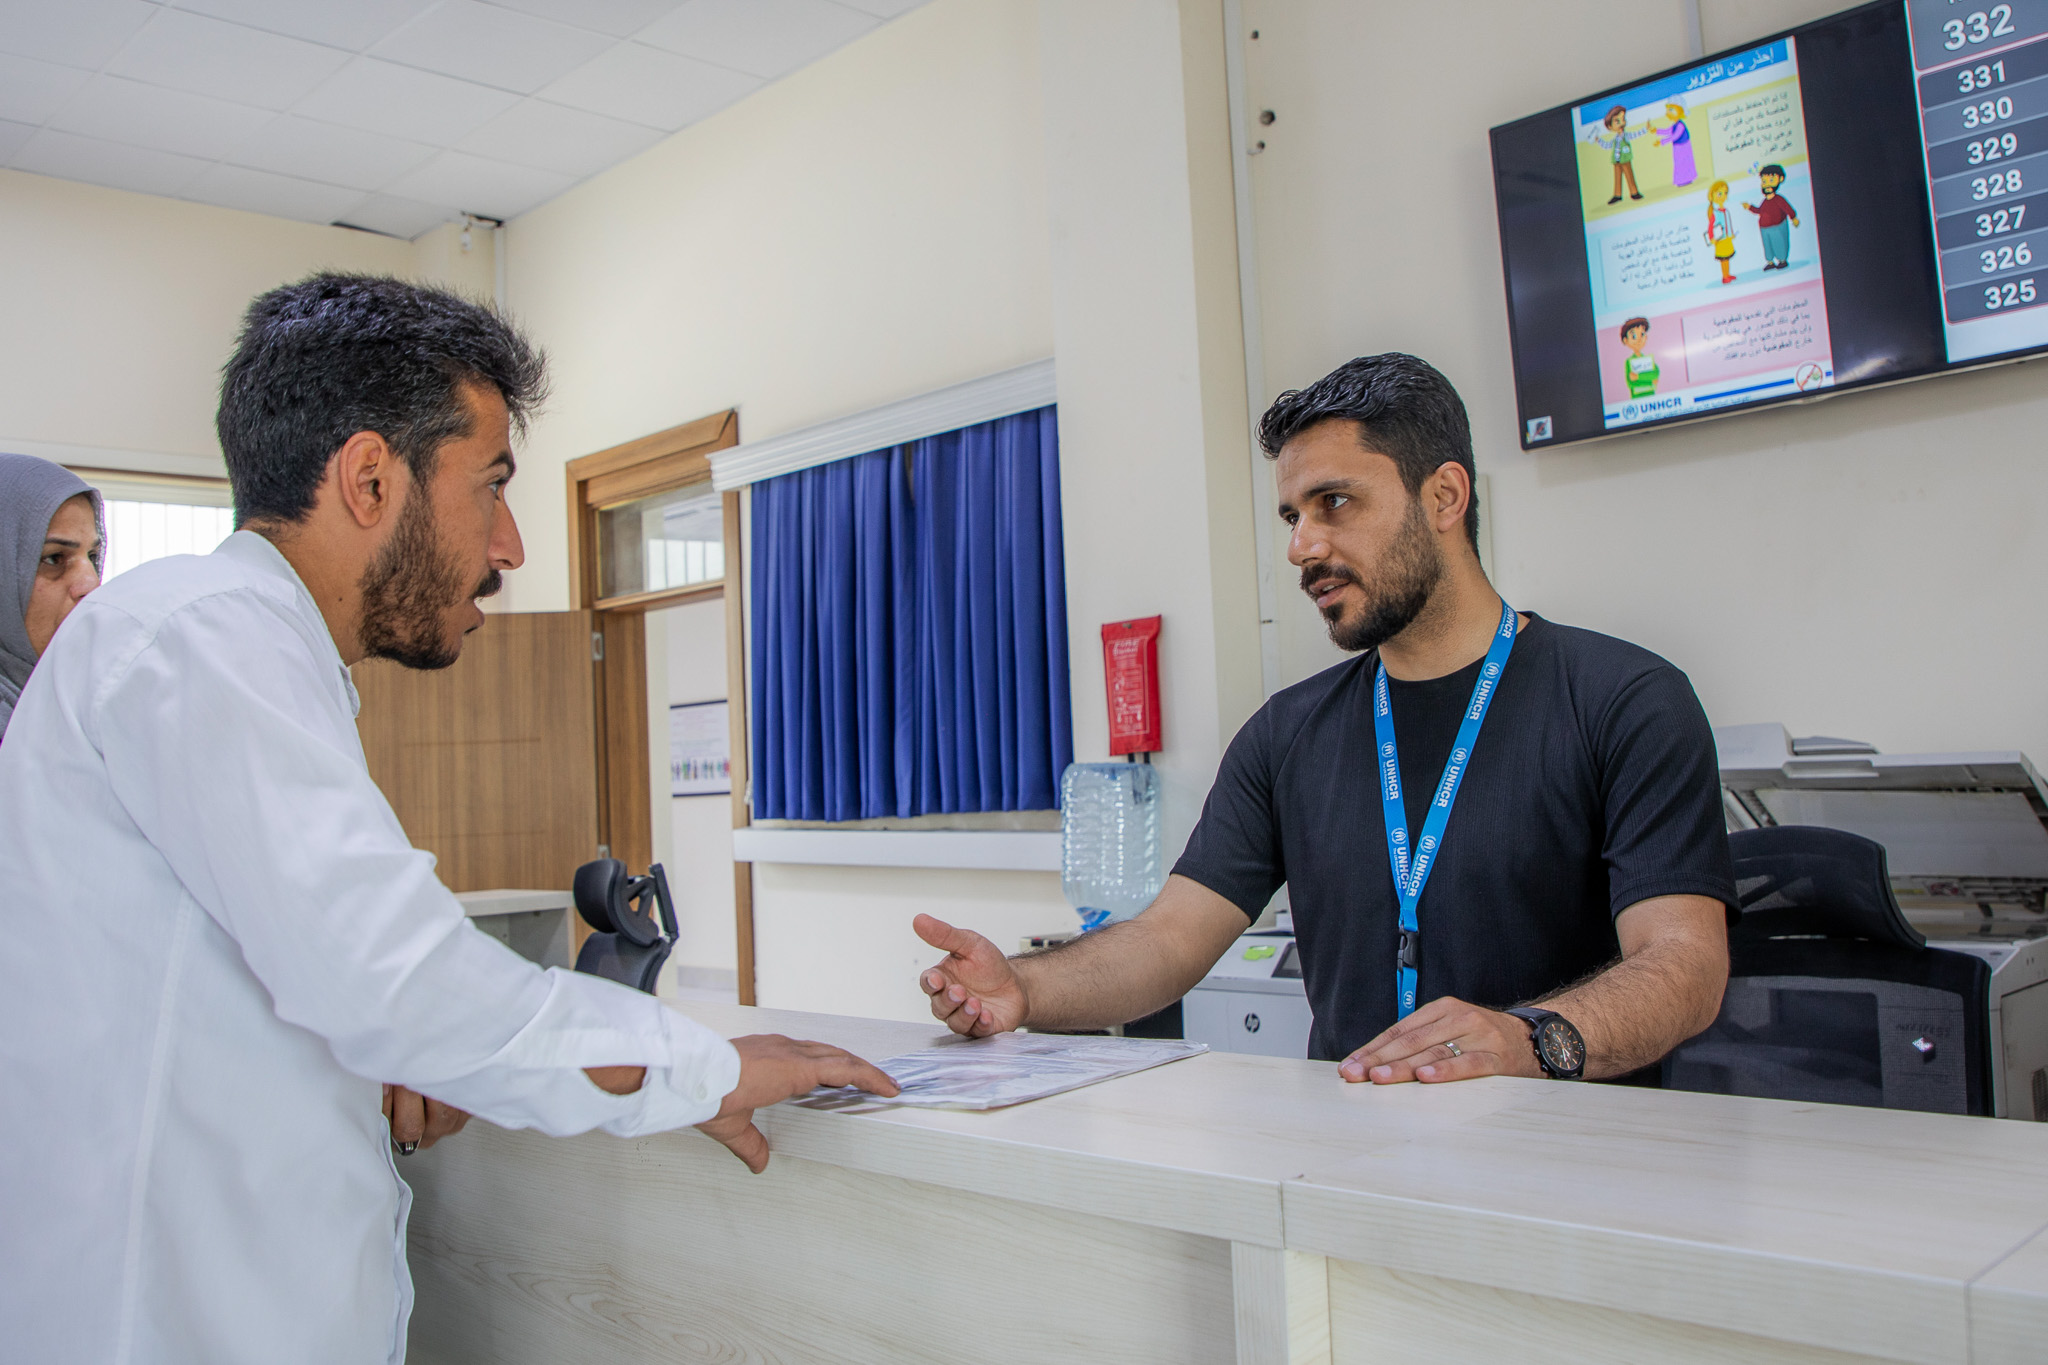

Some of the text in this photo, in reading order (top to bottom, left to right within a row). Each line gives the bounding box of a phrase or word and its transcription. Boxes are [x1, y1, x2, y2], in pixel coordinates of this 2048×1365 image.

[1942, 4, 2016, 51] 332
[1687, 63, 1724, 90] التزوير
[1727, 61, 1744, 77] من
[1958, 60, 2006, 93] 331
[1962, 96, 2014, 129] 330
[1966, 132, 2018, 164] 329
[1971, 169, 2023, 201] 328
[1975, 204, 2027, 237] 327
[1980, 242, 2032, 273] 326
[1984, 278, 2037, 310] 325
[1640, 397, 1682, 414] UNHCR
[1501, 606, 1515, 639] UNHCR
[1378, 678, 1389, 716] UNHCR
[1469, 679, 1493, 721] UNHCR
[1386, 759, 1399, 800] UNHCR
[1437, 766, 1461, 808] UNHCR
[1408, 854, 1430, 898] UNHCR
[1244, 1012, 1261, 1034] hp
